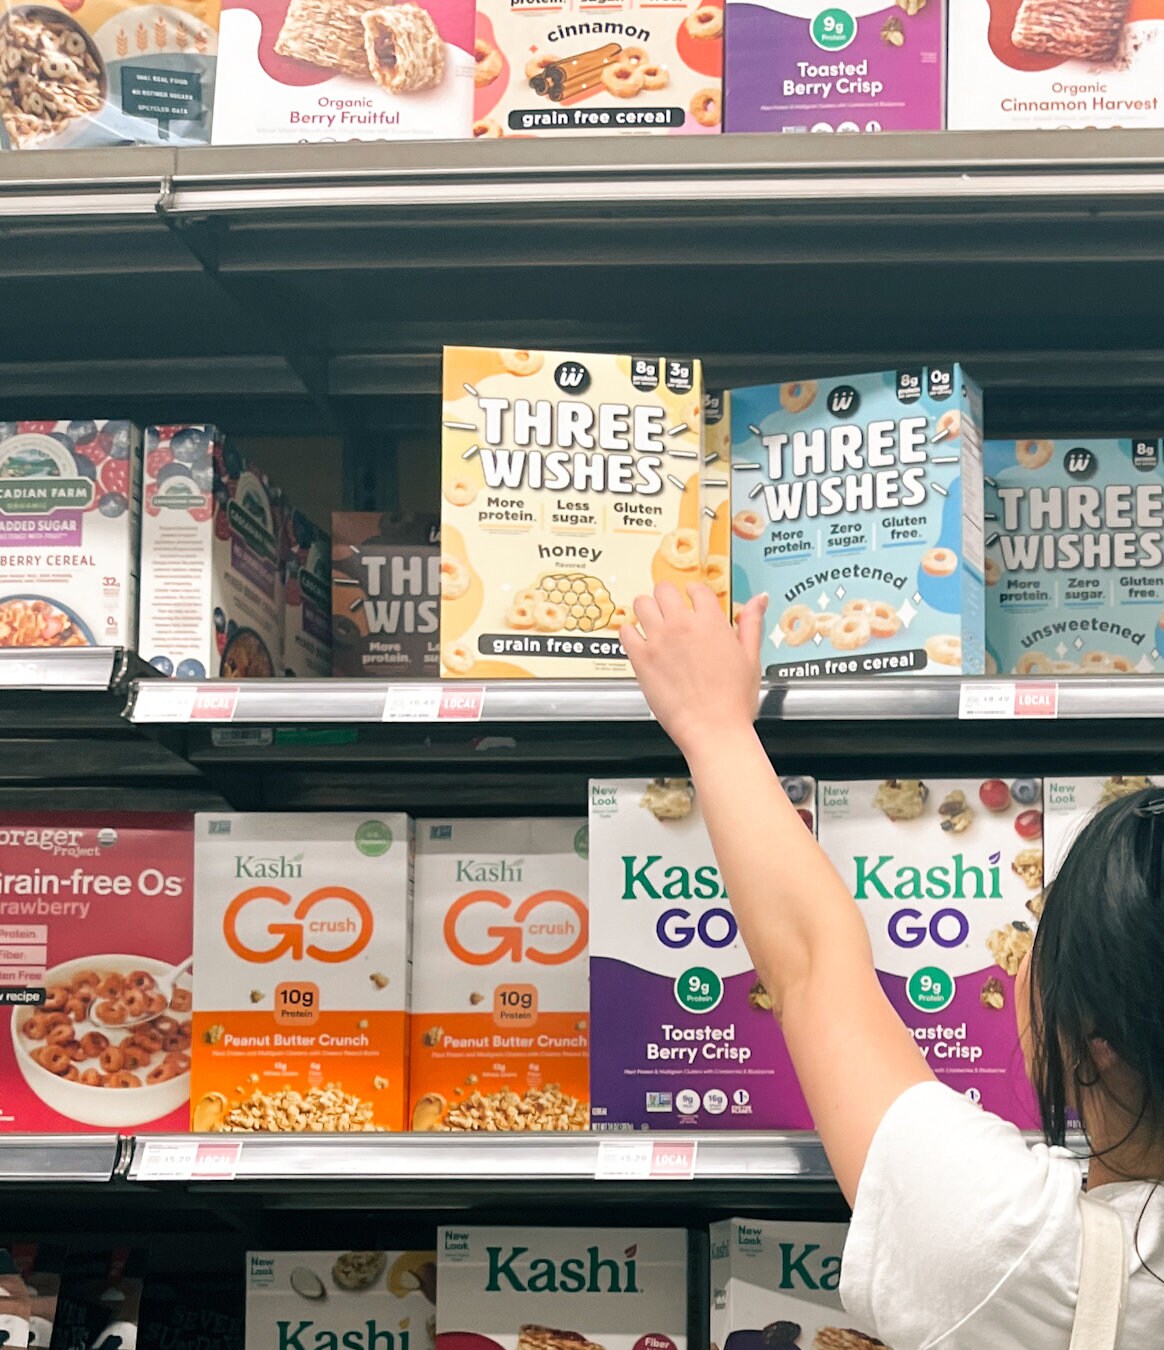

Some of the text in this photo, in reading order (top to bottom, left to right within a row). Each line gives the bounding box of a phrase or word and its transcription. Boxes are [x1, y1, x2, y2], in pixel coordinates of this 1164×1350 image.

[547, 22, 650, 43] cinnamon
[798, 61, 867, 78] Toasted
[783, 80, 883, 98] Berry Crisp
[1052, 82, 1107, 95] Organic
[1001, 98, 1158, 112] Cinnamon Harvest
[289, 111, 400, 127] Berry Fruitful
[479, 398, 664, 452] THREE
[763, 417, 927, 479] THREE
[479, 449, 663, 495] WISHES
[487, 498, 524, 508] More
[764, 467, 926, 522] WISHES
[557, 500, 590, 511] Less
[614, 503, 662, 515] Gluten
[998, 484, 1163, 531] THREE
[830, 522, 862, 535] Zero
[882, 515, 927, 528] Gluten
[891, 528, 921, 539] free.
[538, 544, 602, 562] honey
[1000, 532, 1163, 571] WISHES
[46, 554, 96, 567] CEREAL
[785, 564, 908, 602] unsweetened
[1020, 617, 1145, 649] unsweetened
[493, 638, 584, 654] grain free
[592, 786, 617, 796] New
[823, 786, 849, 797] New
[592, 796, 617, 806] Look
[53, 846, 101, 857] Project
[234, 855, 302, 879] Kashi
[853, 850, 1003, 900] Kashi
[309, 918, 356, 933] crush
[656, 908, 738, 949] GO
[888, 908, 969, 948] GO
[920, 976, 941, 995] 9g
[224, 1034, 369, 1047] Peanut Butter Crunch
[661, 1024, 735, 1041] Toasted
[647, 1044, 751, 1064] Berry Crisp
[933, 1042, 983, 1063] Crisp
[486, 1244, 638, 1293] Kashi
[644, 1338, 670, 1349] Fiber
